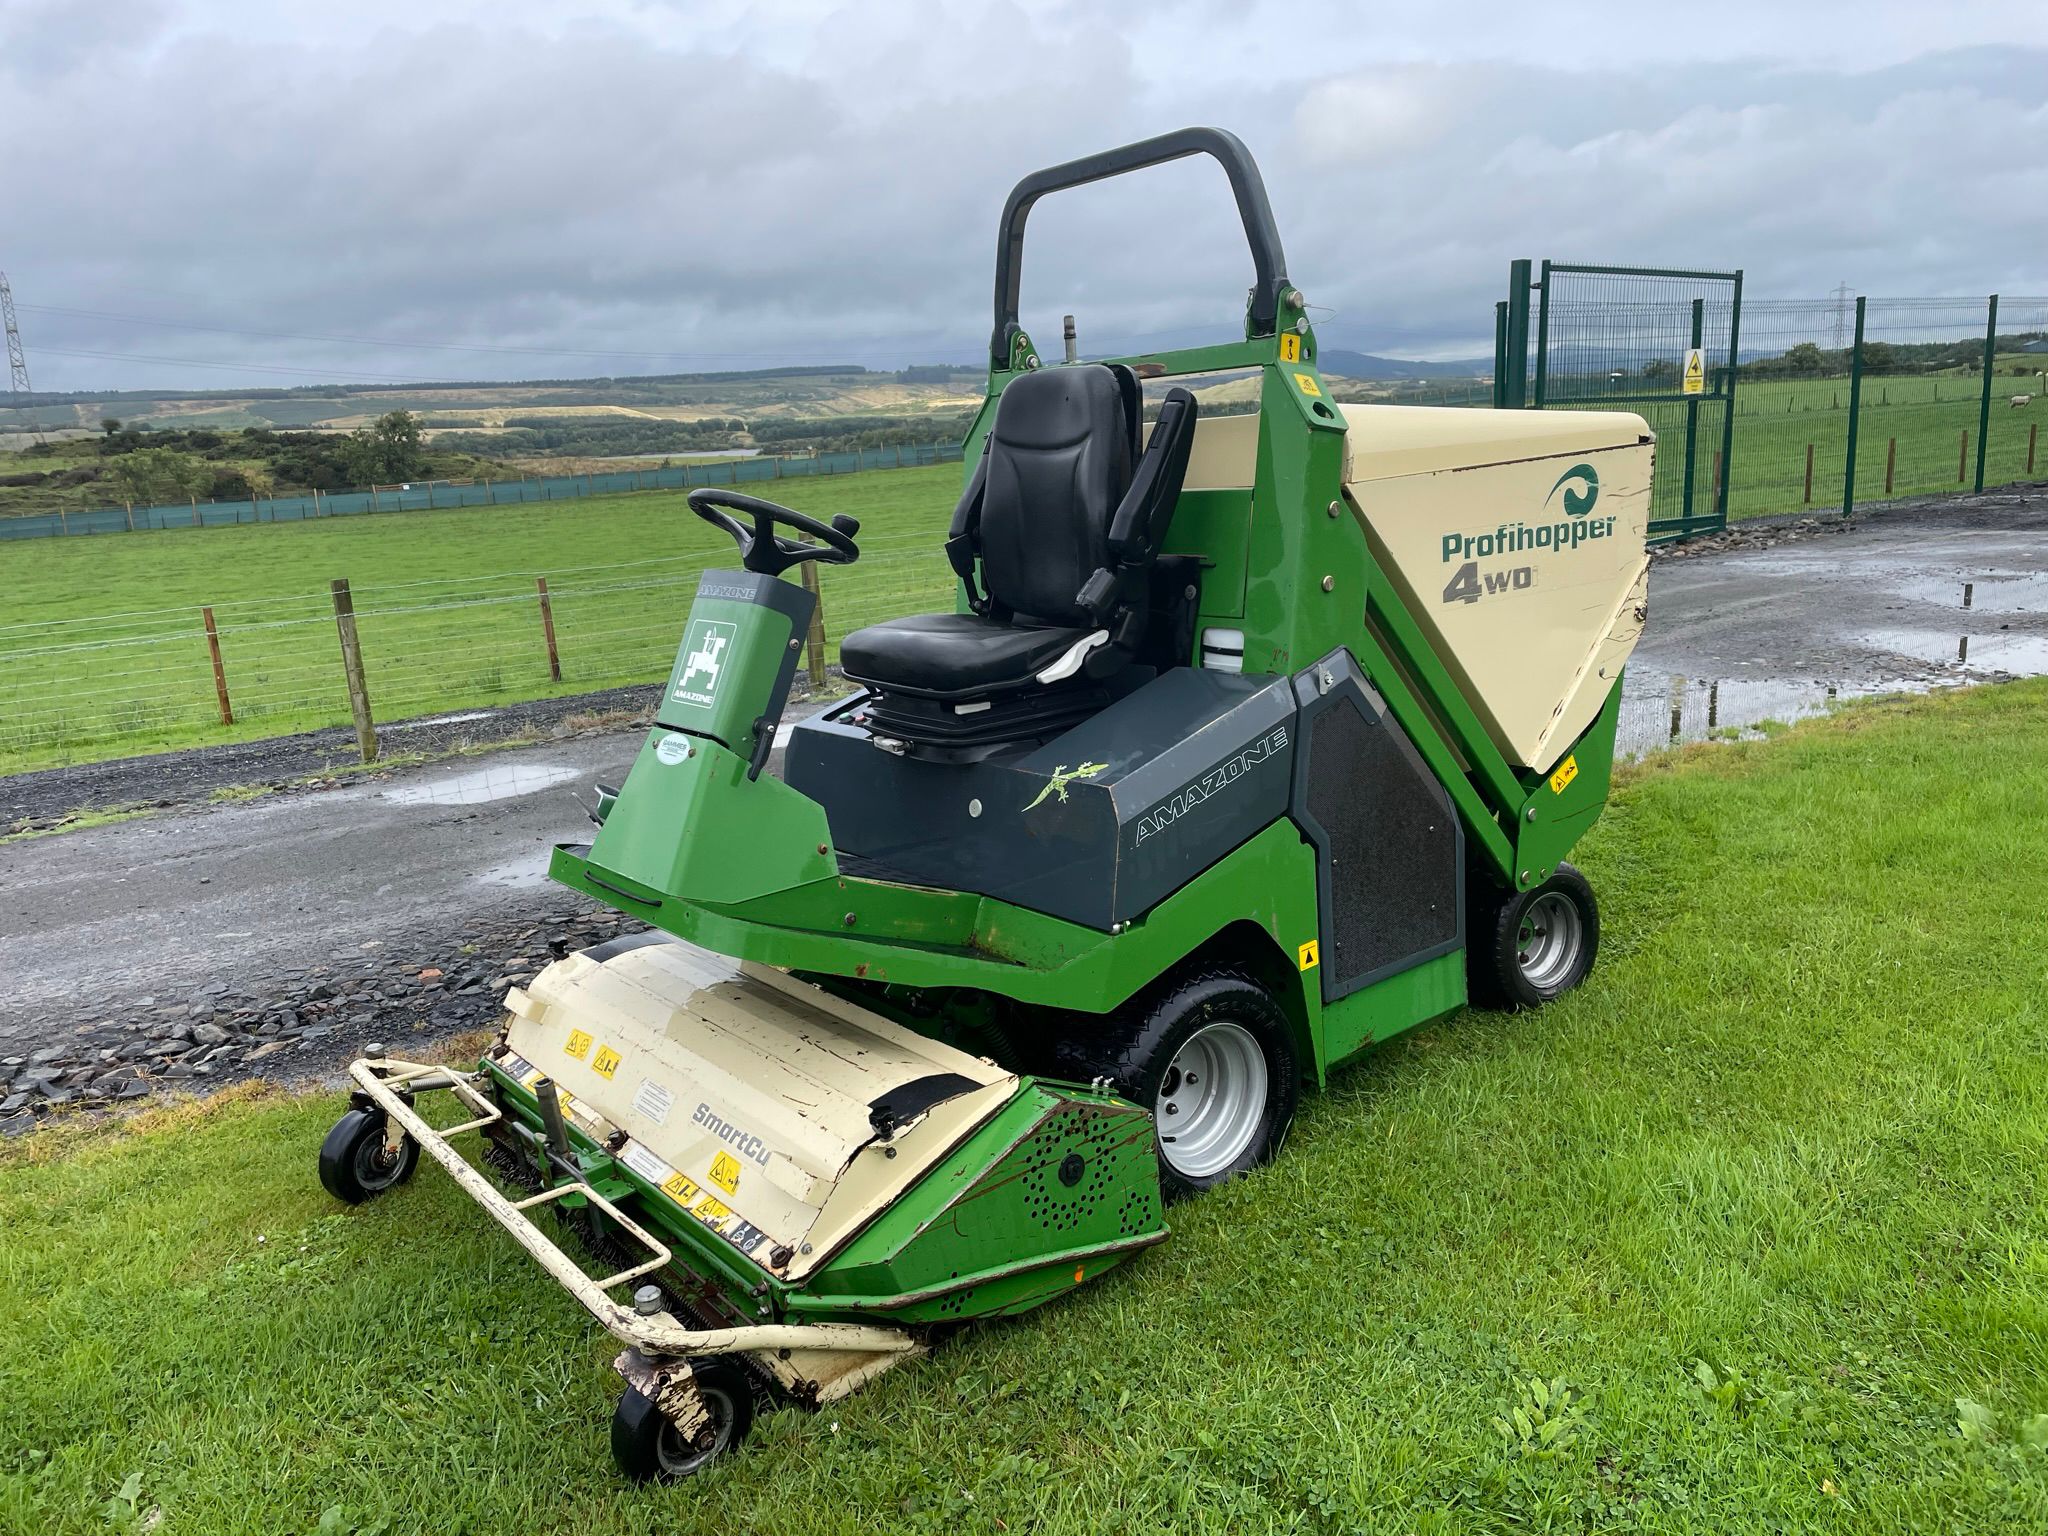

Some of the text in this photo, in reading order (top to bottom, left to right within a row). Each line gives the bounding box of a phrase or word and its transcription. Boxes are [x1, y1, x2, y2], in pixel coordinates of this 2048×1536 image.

[1442, 516, 1616, 562] Profihopper
[697, 584, 757, 600] AMAZONE
[673, 689, 715, 704] AMAZONE
[1136, 727, 1288, 847] AMAZONE
[692, 1102, 772, 1166] SmartCu
